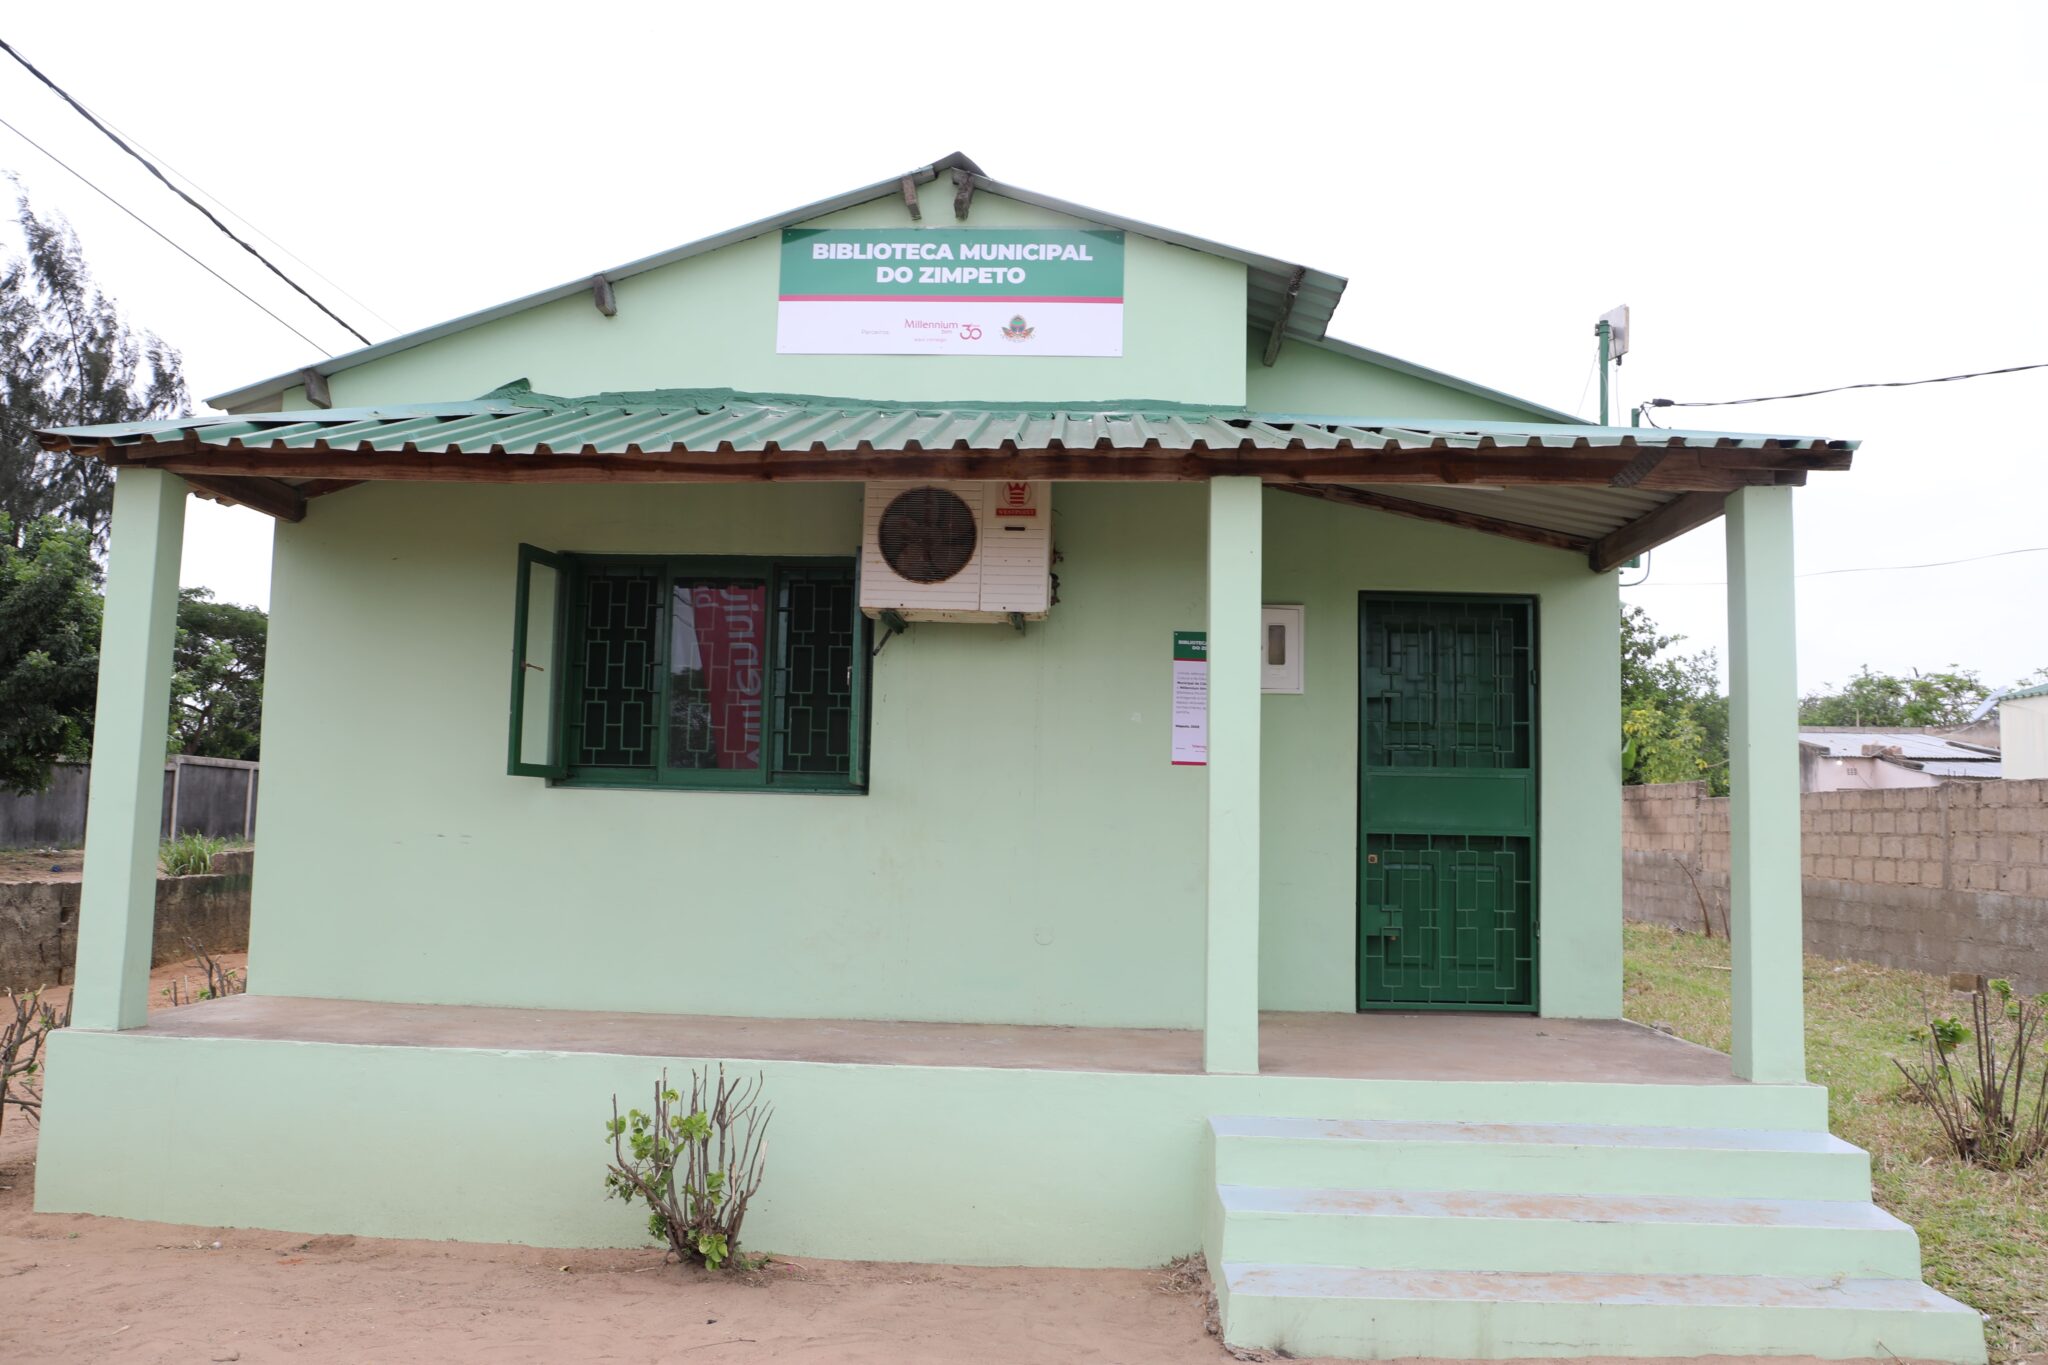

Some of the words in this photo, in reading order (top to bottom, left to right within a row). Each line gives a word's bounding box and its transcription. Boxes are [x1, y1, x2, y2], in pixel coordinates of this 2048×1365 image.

[812, 243, 954, 261] BIBLIOTECA
[960, 244, 1093, 262] MUNICIPAL
[876, 266, 913, 284] DO
[919, 267, 1026, 284] ZIMPETO
[904, 318, 959, 329] Millennium
